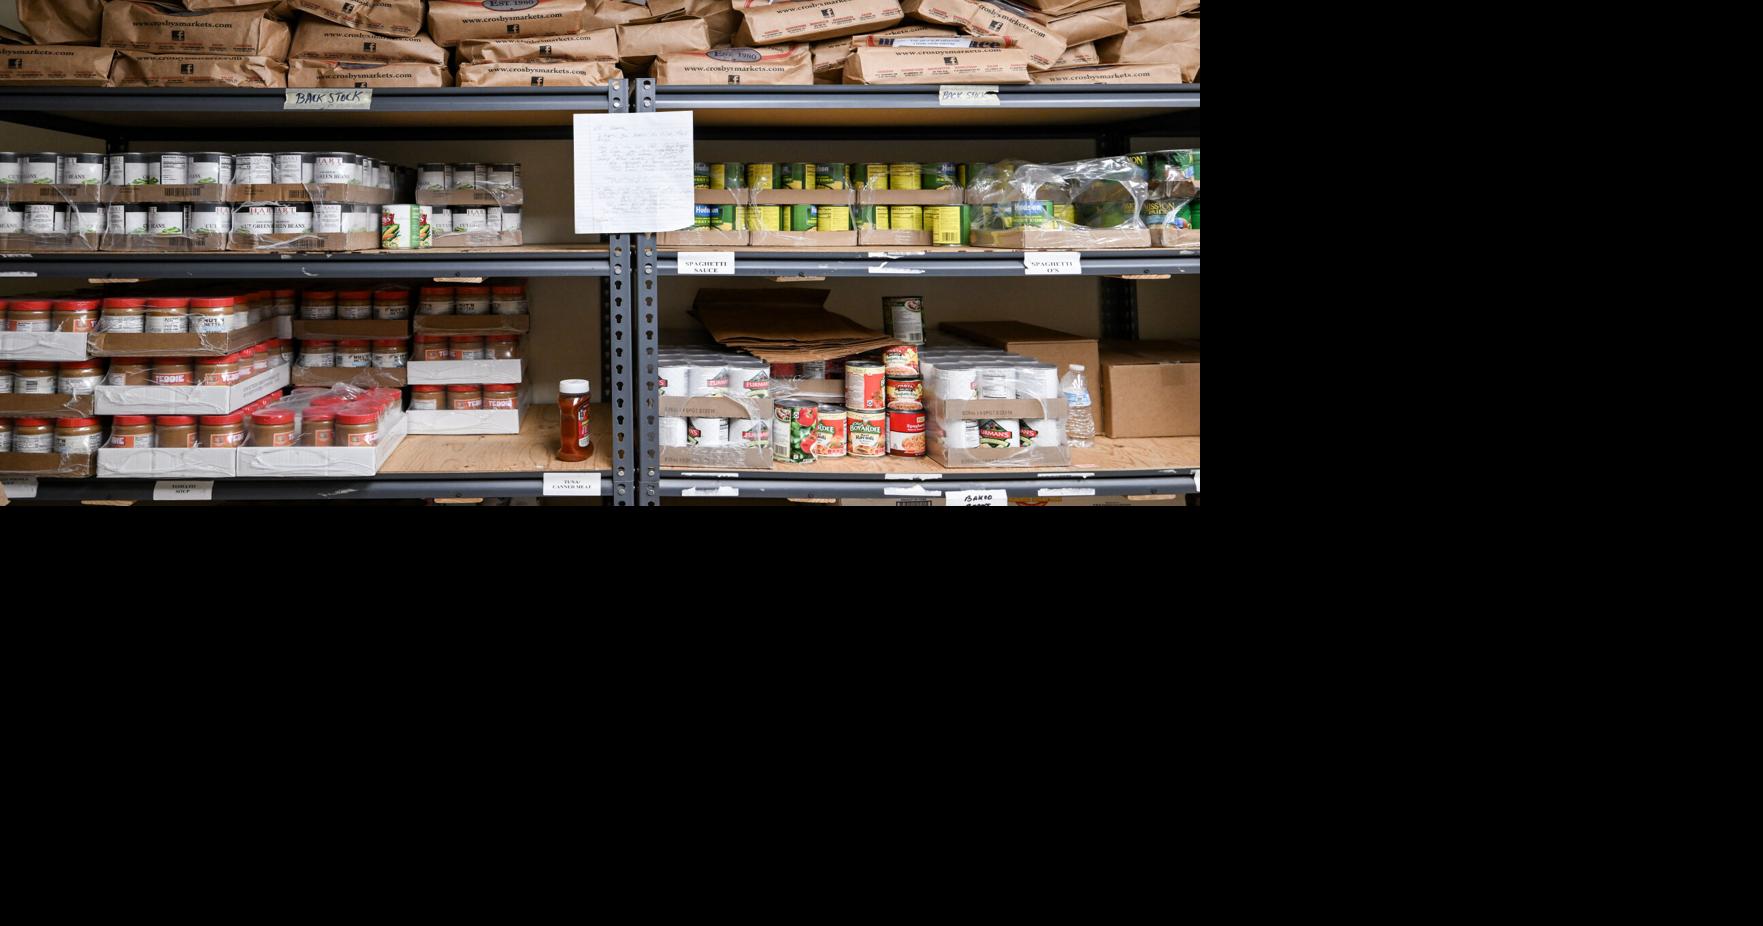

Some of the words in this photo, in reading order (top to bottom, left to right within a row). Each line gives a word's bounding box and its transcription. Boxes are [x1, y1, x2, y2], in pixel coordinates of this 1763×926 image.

[462, 12, 563, 24] www.crosbysmarkets.com
[132, 20, 233, 30] www.crosbysmarkets.com
[488, 66, 587, 76] www.crosbysmarkets.com
[684, 64, 785, 73] www.crosbysmarkets.com
[316, 71, 412, 81] www.crosbysmarkets.com
[1049, 71, 1151, 82] www.crosbysmarkets.com
[296, 92, 326, 105] BACK
[328, 90, 364, 104] STOCK
